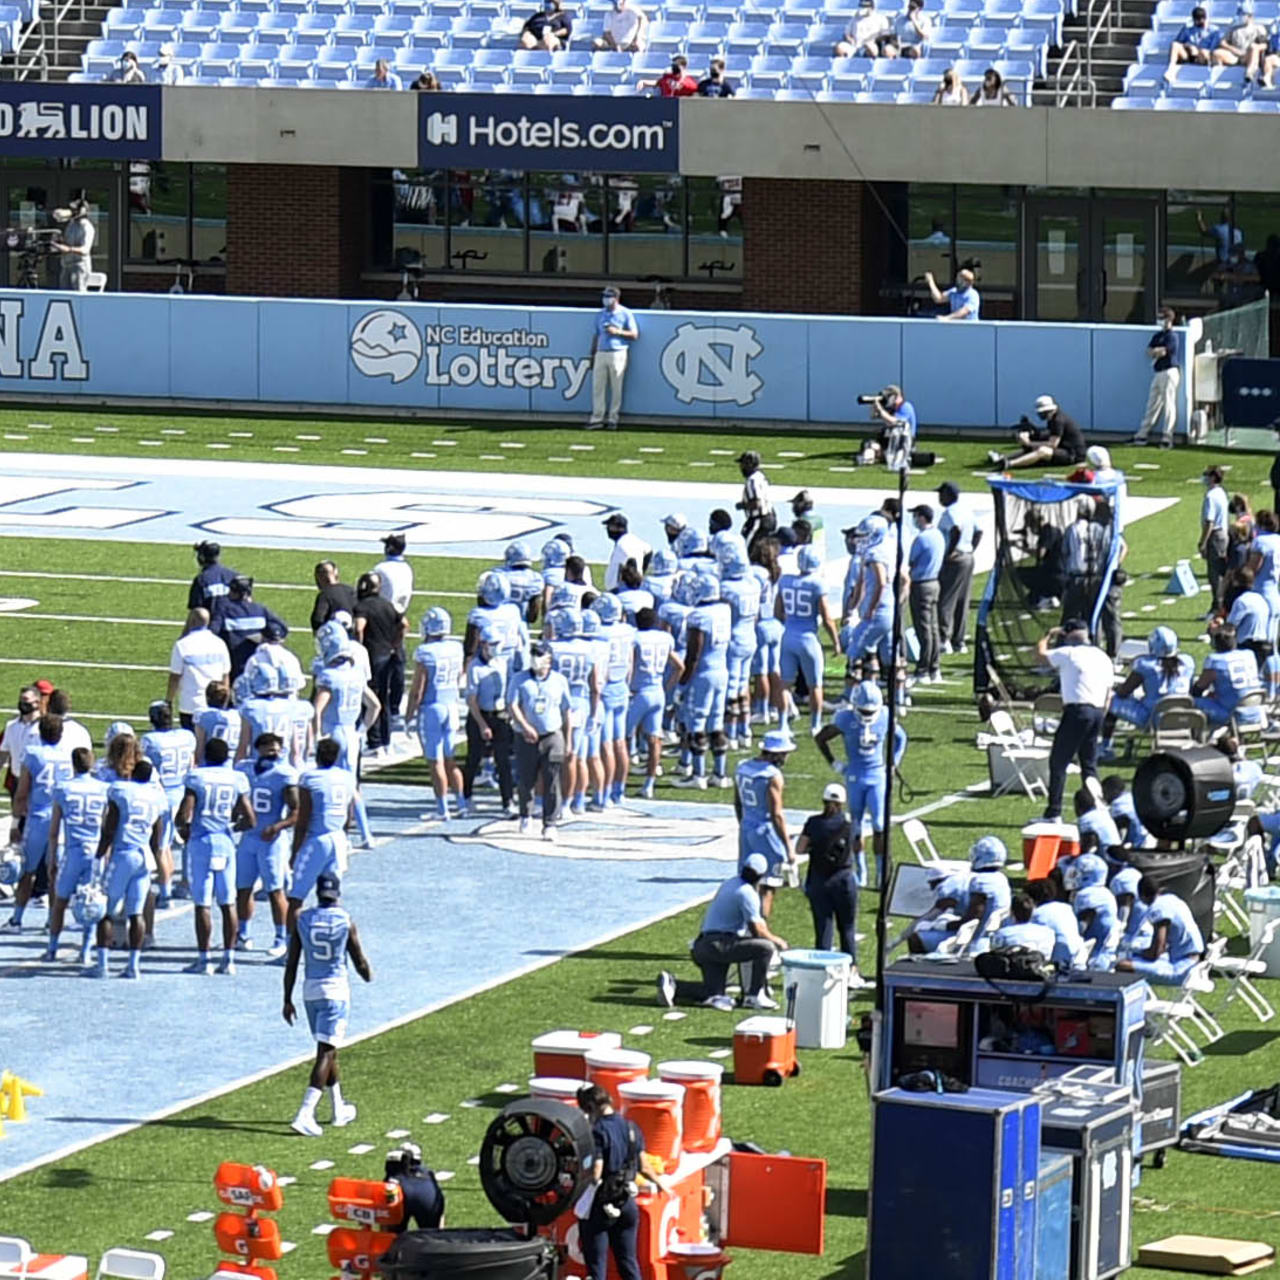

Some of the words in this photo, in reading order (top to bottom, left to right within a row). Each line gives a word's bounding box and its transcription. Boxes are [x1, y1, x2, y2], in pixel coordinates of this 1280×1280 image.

[71, 104, 148, 141] LION
[468, 111, 665, 151] Hotels.com
[425, 325, 456, 344] NC
[458, 326, 549, 349] Education
[425, 346, 593, 400] Lottery
[782, 589, 813, 617] 95
[202, 784, 235, 818] 18
[253, 788, 272, 813] 6
[354, 1254, 370, 1270] G
